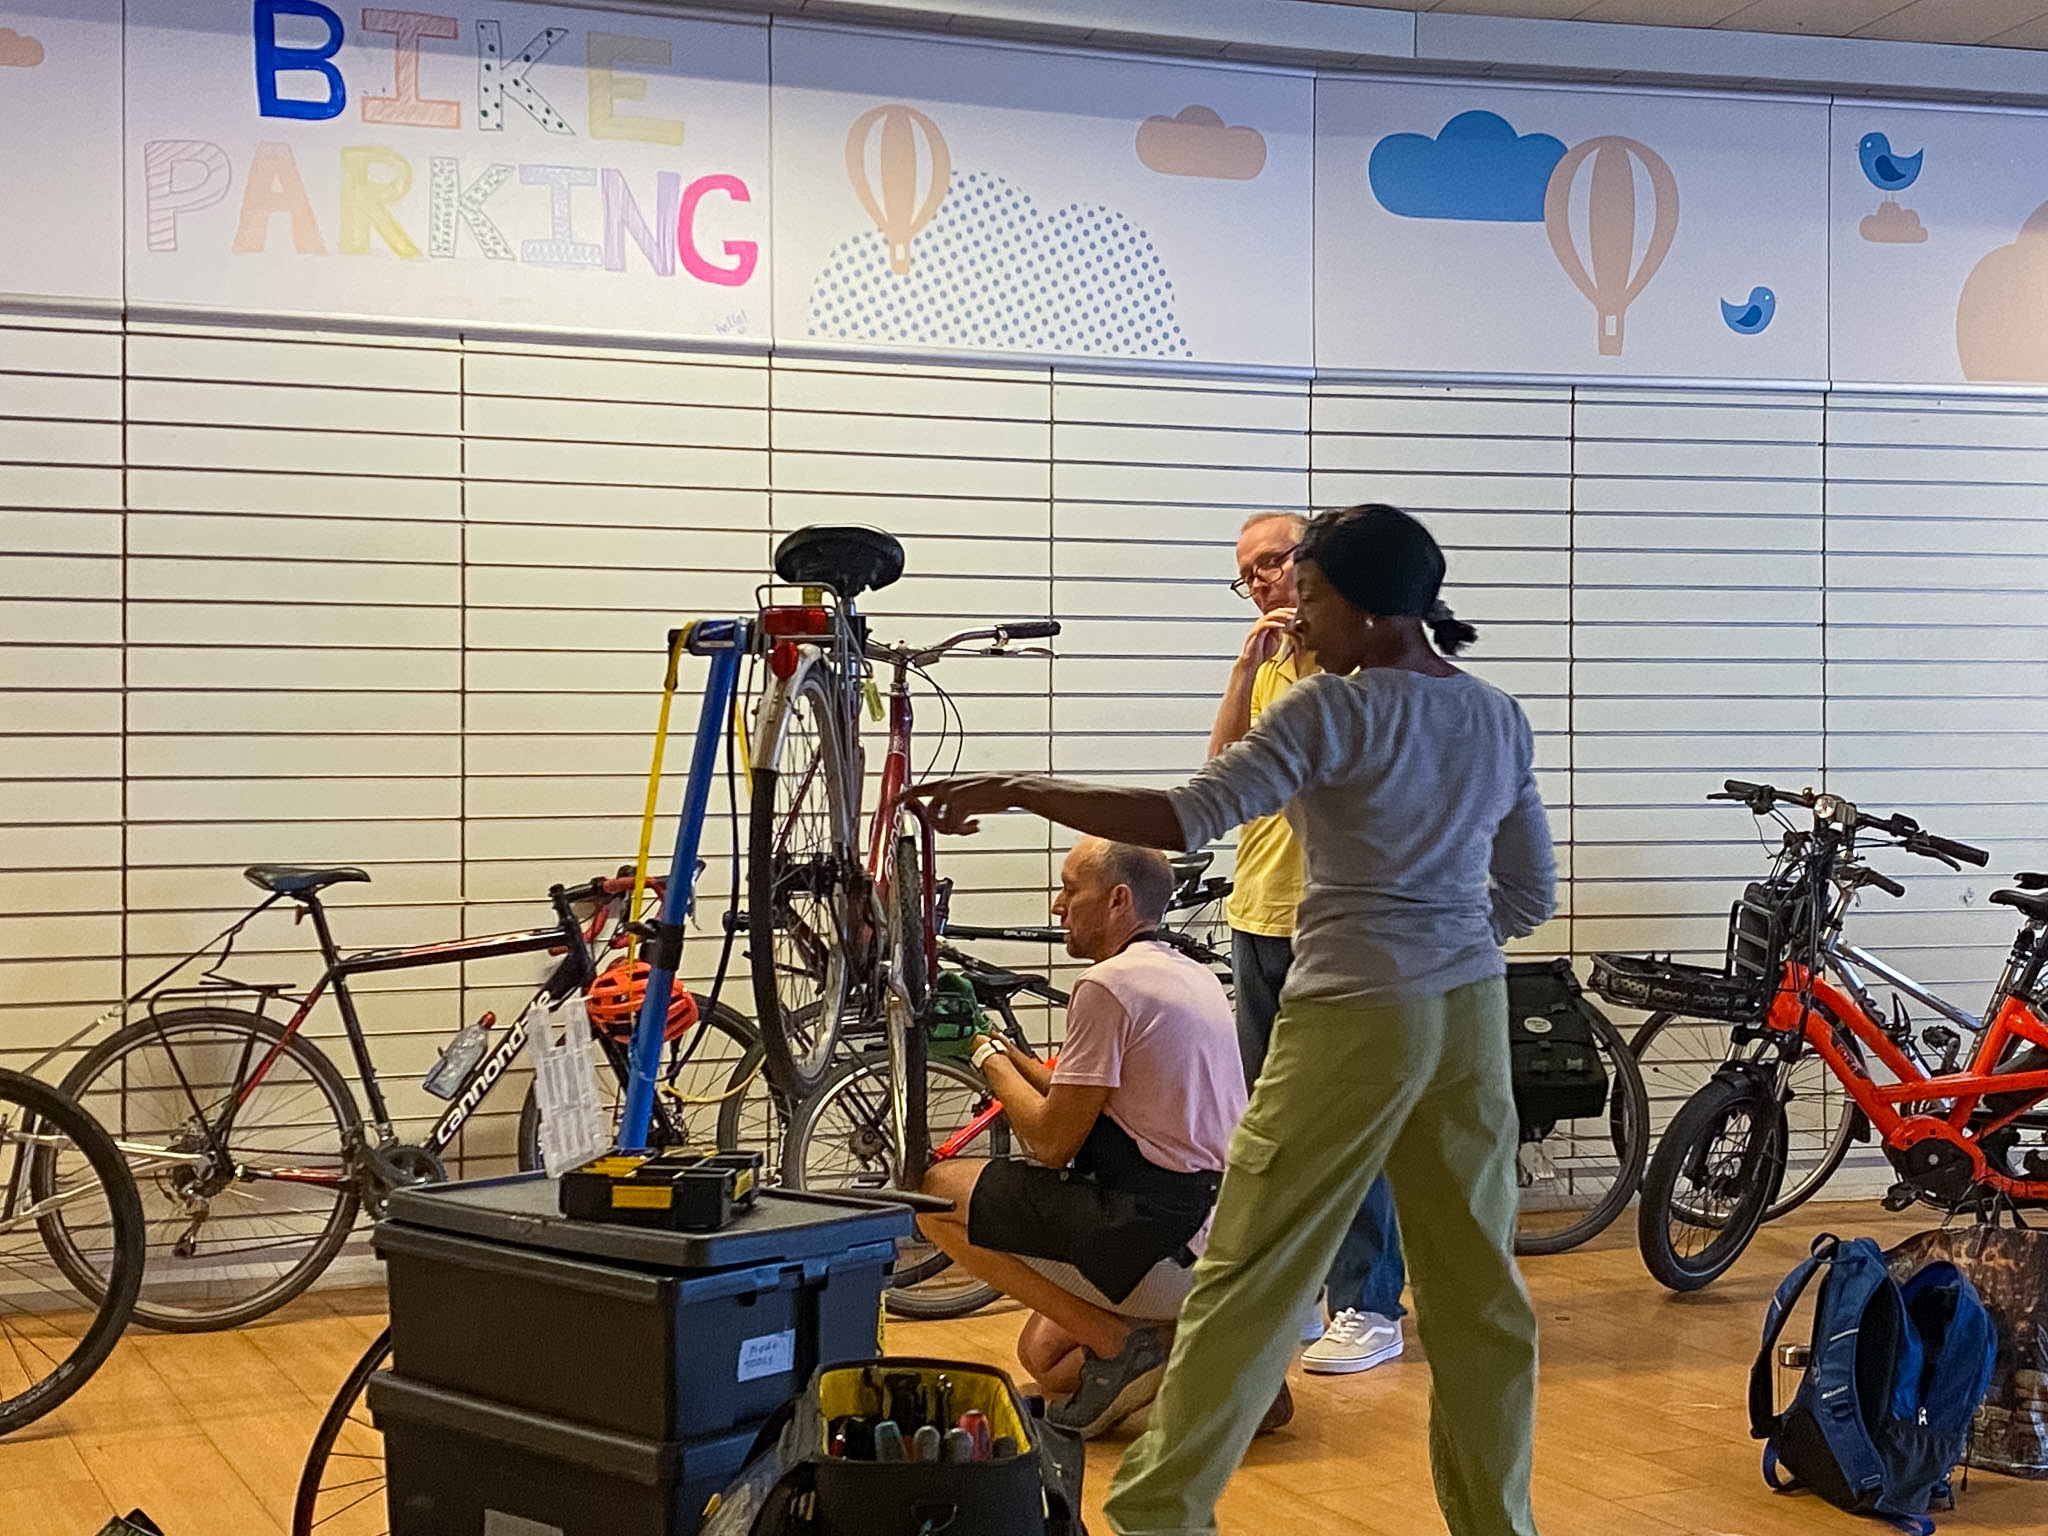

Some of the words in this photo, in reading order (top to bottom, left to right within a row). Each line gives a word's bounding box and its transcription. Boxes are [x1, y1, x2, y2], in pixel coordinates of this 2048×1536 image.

[254, 0, 685, 146] BIKE
[144, 140, 759, 287] PARKING
[436, 990, 551, 1146] cannonde
